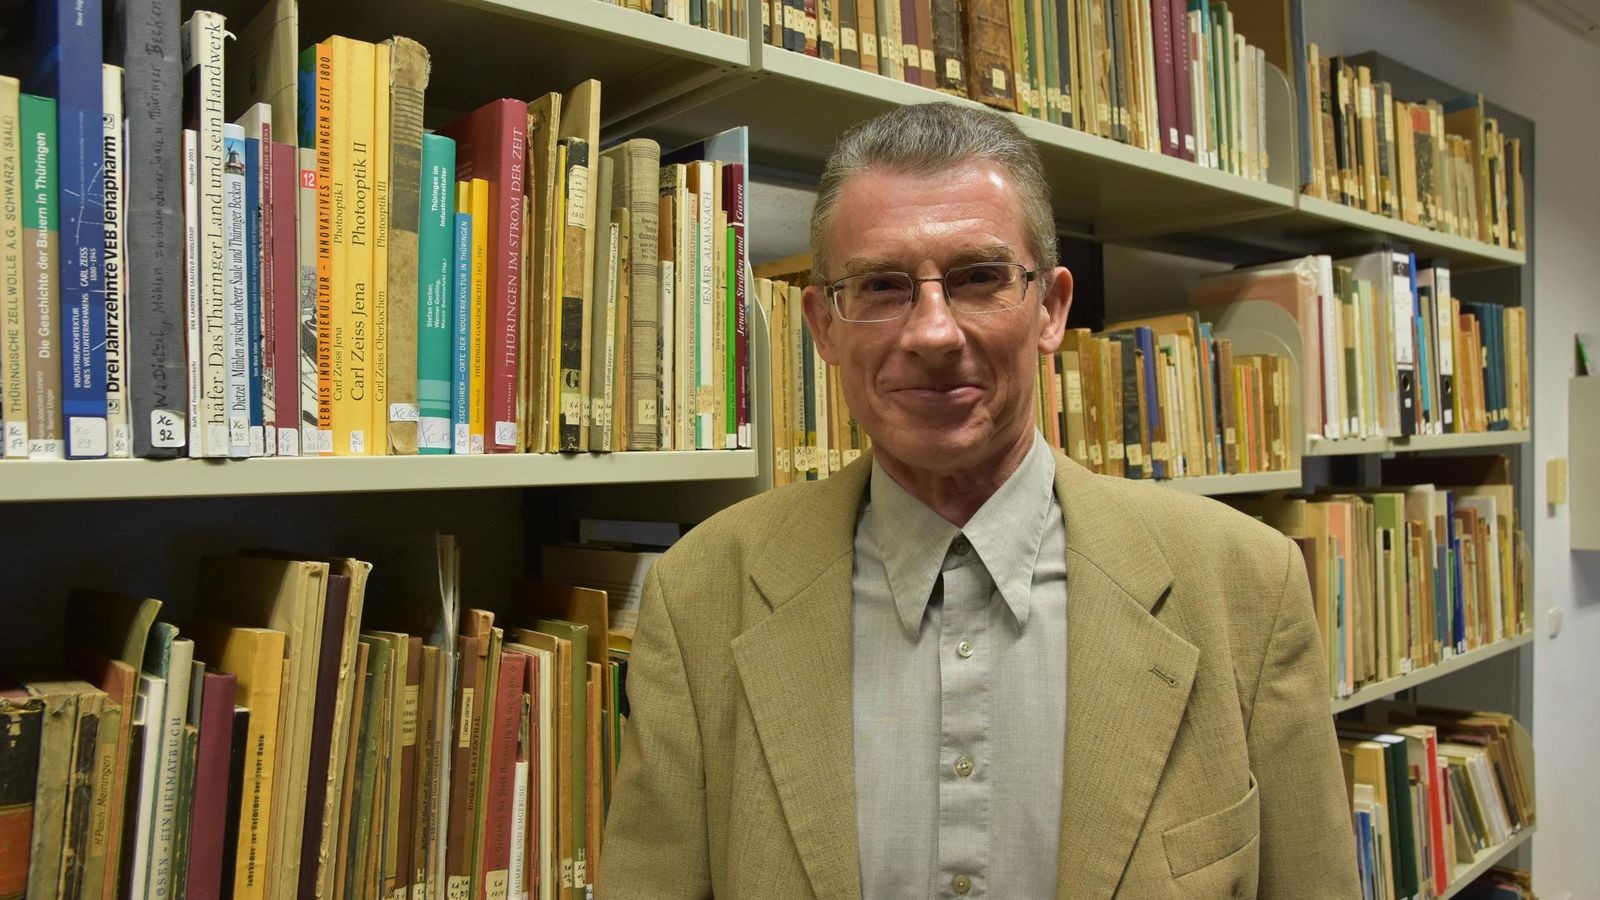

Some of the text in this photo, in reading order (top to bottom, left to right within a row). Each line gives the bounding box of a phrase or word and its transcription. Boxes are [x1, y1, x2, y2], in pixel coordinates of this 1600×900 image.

[205, 21, 221, 113] Handwerk
[320, 56, 330, 81] 1800
[320, 86, 330, 111] SEIT
[3, 115, 15, 152] (SAALE)
[205, 118, 221, 152] sein
[317, 116, 330, 179] THÜRINGEN
[512, 126, 523, 160] ZEIT
[4, 156, 18, 221] SCHWARZA
[205, 156, 221, 190] und
[303, 173, 315, 187] 12
[351, 140, 370, 246] Photooptik II
[431, 165, 440, 212] Thüringen im
[439, 166, 447, 227] Industriezeitalter
[511, 164, 521, 192] DER
[205, 193, 222, 238] Land
[319, 185, 330, 259] INNOVATIVES
[333, 188, 345, 245] Photooptik
[376, 180, 388, 248] Photooptik III
[509, 196, 521, 249] STROM
[35, 132, 50, 358] Die Geschichte der Bauern in Thüringen
[80, 247, 89, 287] CARL ZEISS
[103, 136, 119, 392] Drei Jahrzehnte VEB Jenapharm
[460, 221, 468, 261] THÜRINGEN
[460, 263, 467, 271] IN
[508, 251, 519, 270] IM
[702, 191, 712, 305] JENAER ALMANACH
[736, 183, 746, 336] Jenaer Straßen und Gassen
[206, 242, 224, 333] Thüringer
[228, 181, 246, 411] Dietzel Mühlen zwischen oberer Saale und Thüringer Becken
[459, 273, 467, 334] INDUSTRIEKULTUR
[664, 265, 672, 294] JENA
[72, 307, 81, 388] INDUSTRIEARCHITEKTUR
[81, 293, 91, 388] EINES WELTUNTERNEHMENS
[319, 277, 330, 381] INDUSTRIEKULTUR
[350, 282, 367, 401] Carl Zeiss Jena
[375, 290, 385, 402] Carl Zeiss Oberkochen
[459, 336, 467, 351] DER
[504, 275, 518, 367] THÜRINGEN
[7, 330, 21, 414] THÜRINGISCHE
[208, 336, 224, 368] Das
[332, 327, 344, 401] Carl Zeiss Jena
[566, 370, 579, 389] G
[156, 414, 174, 426] Xc
[159, 429, 175, 442] 92
[96, 754, 112, 807] Meiningen
[161, 717, 180, 812] HEIMATBUCH
[160, 818, 172, 841] EIN
[516, 785, 525, 830] UMGEBUNG
[514, 850, 522, 896] NAUMBURG
